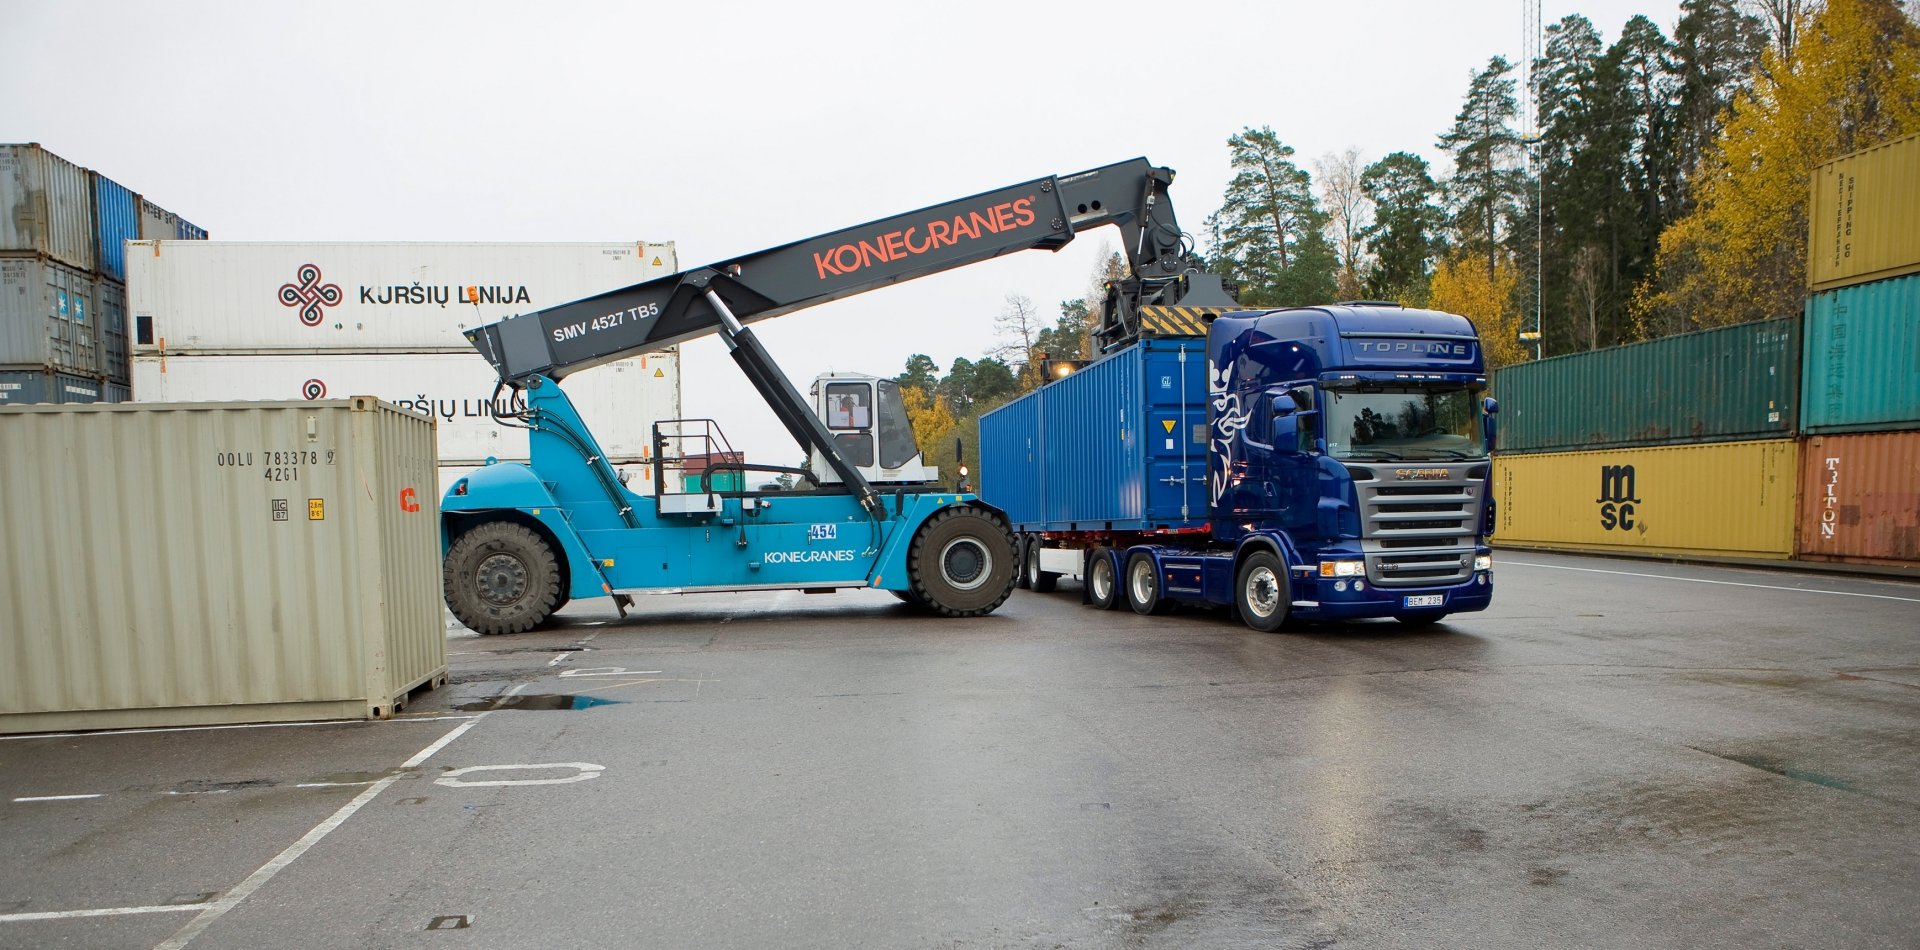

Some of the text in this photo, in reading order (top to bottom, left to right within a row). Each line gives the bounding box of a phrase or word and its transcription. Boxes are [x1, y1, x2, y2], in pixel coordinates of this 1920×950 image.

[1844, 176, 1855, 258] SHIPPING CO
[813, 199, 1036, 280] KONECRANES
[360, 281, 532, 308] KURŠIŲ LNIJA
[553, 302, 659, 342] SMV 4527 TB5
[1359, 342, 1466, 355] TOPLINE
[264, 451, 318, 465] 783378
[327, 450, 335, 464] 9
[264, 467, 298, 481] 42G1
[1395, 468, 1450, 480] SCANIA
[812, 525, 835, 538] 454
[764, 550, 854, 564] KONECRANES
[1408, 596, 1441, 606] BEM 235
